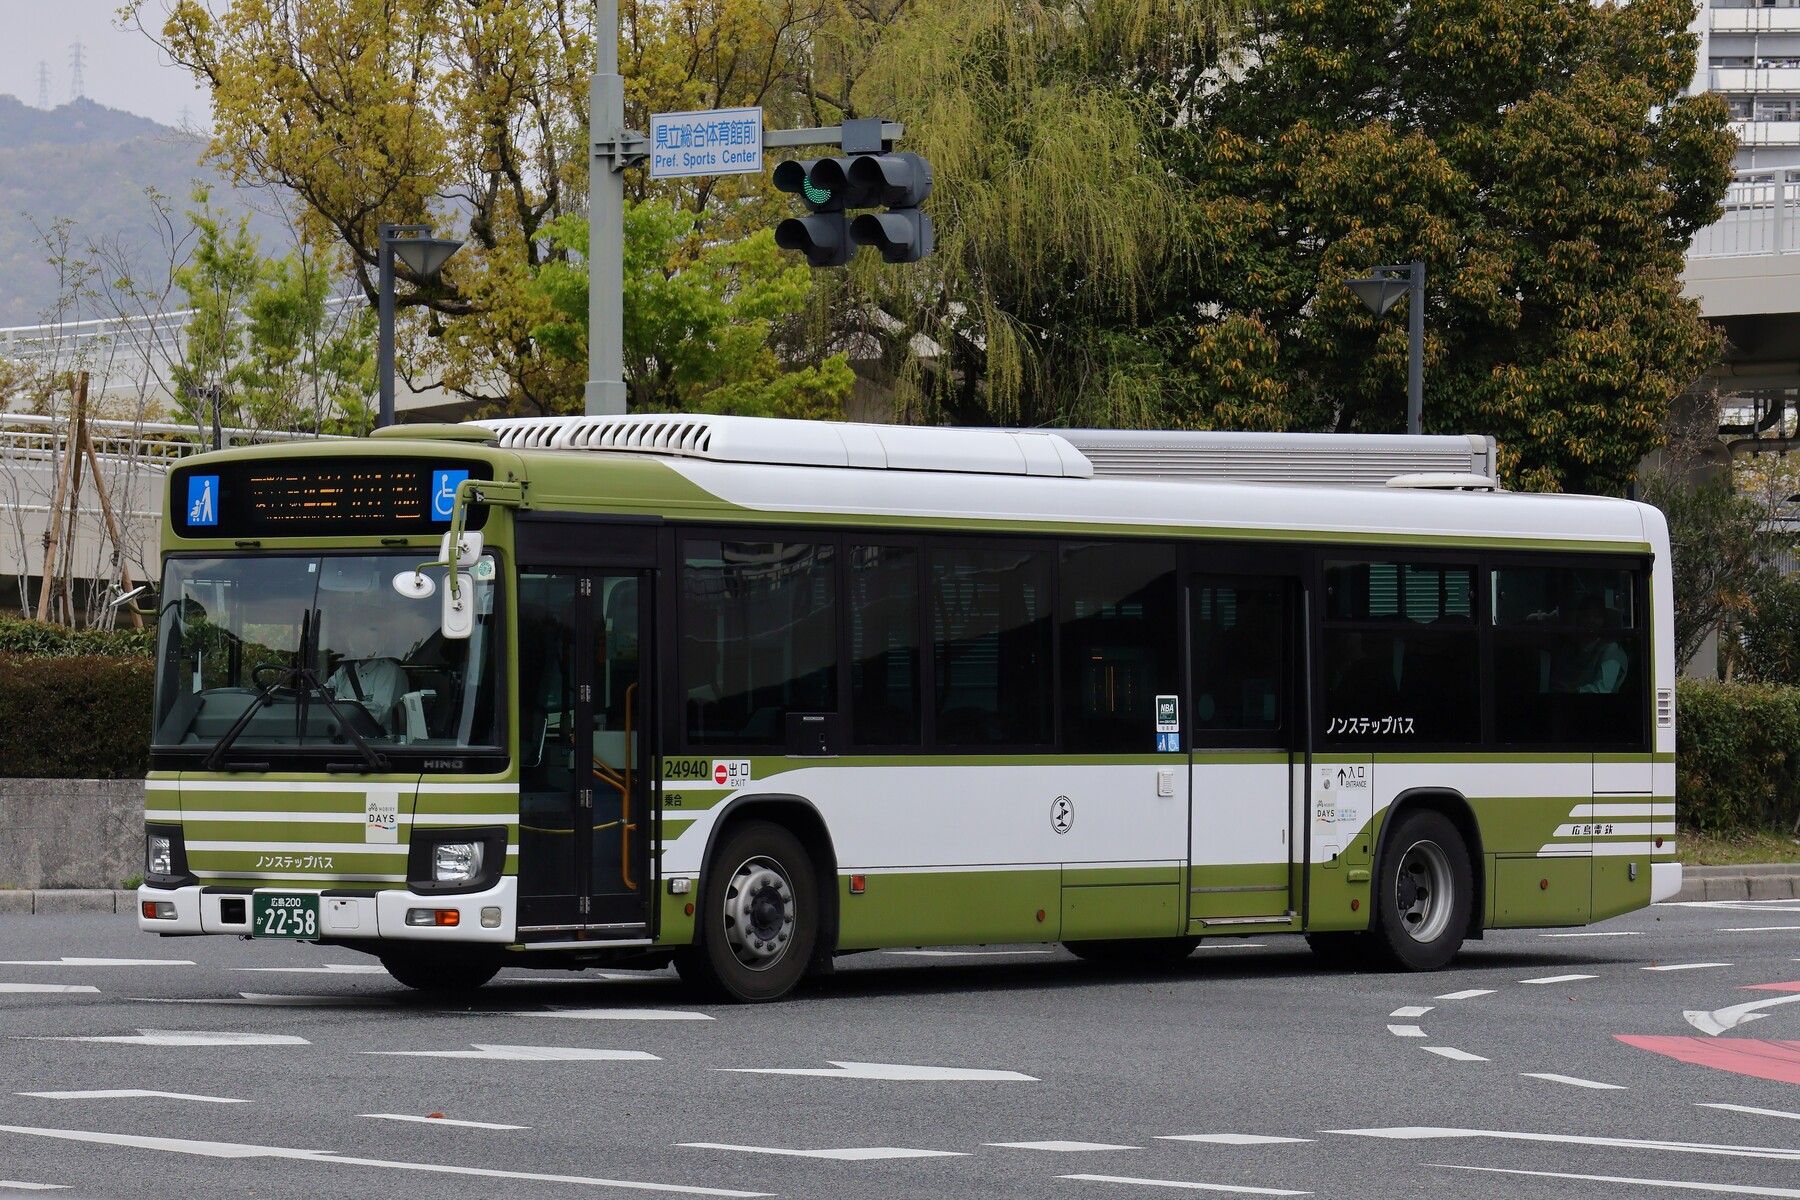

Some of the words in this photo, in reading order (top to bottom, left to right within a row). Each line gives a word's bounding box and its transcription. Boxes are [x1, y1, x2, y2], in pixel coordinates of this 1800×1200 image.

[656, 119, 756, 149] 県立総合体育館前
[655, 154, 679, 168] Pref.
[683, 151, 716, 169] Sports
[722, 149, 757, 164] Center
[1160, 703, 1175, 713] NBA
[1326, 715, 1415, 734] ノンステップバス
[423, 760, 464, 769] HINO
[664, 760, 708, 778] 24940
[728, 762, 749, 777] 出口
[1348, 766, 1365, 779] 入口
[730, 778, 746, 787] EXIT
[1345, 780, 1367, 788] ENTRANCE
[664, 793, 682, 807] 乗合
[368, 814, 395, 823] DAYS
[1317, 809, 1335, 818] DAYS
[1571, 824, 1614, 836] 広島電鉄
[255, 855, 334, 869] ノンステップバス
[264, 908, 316, 935] 22-58
